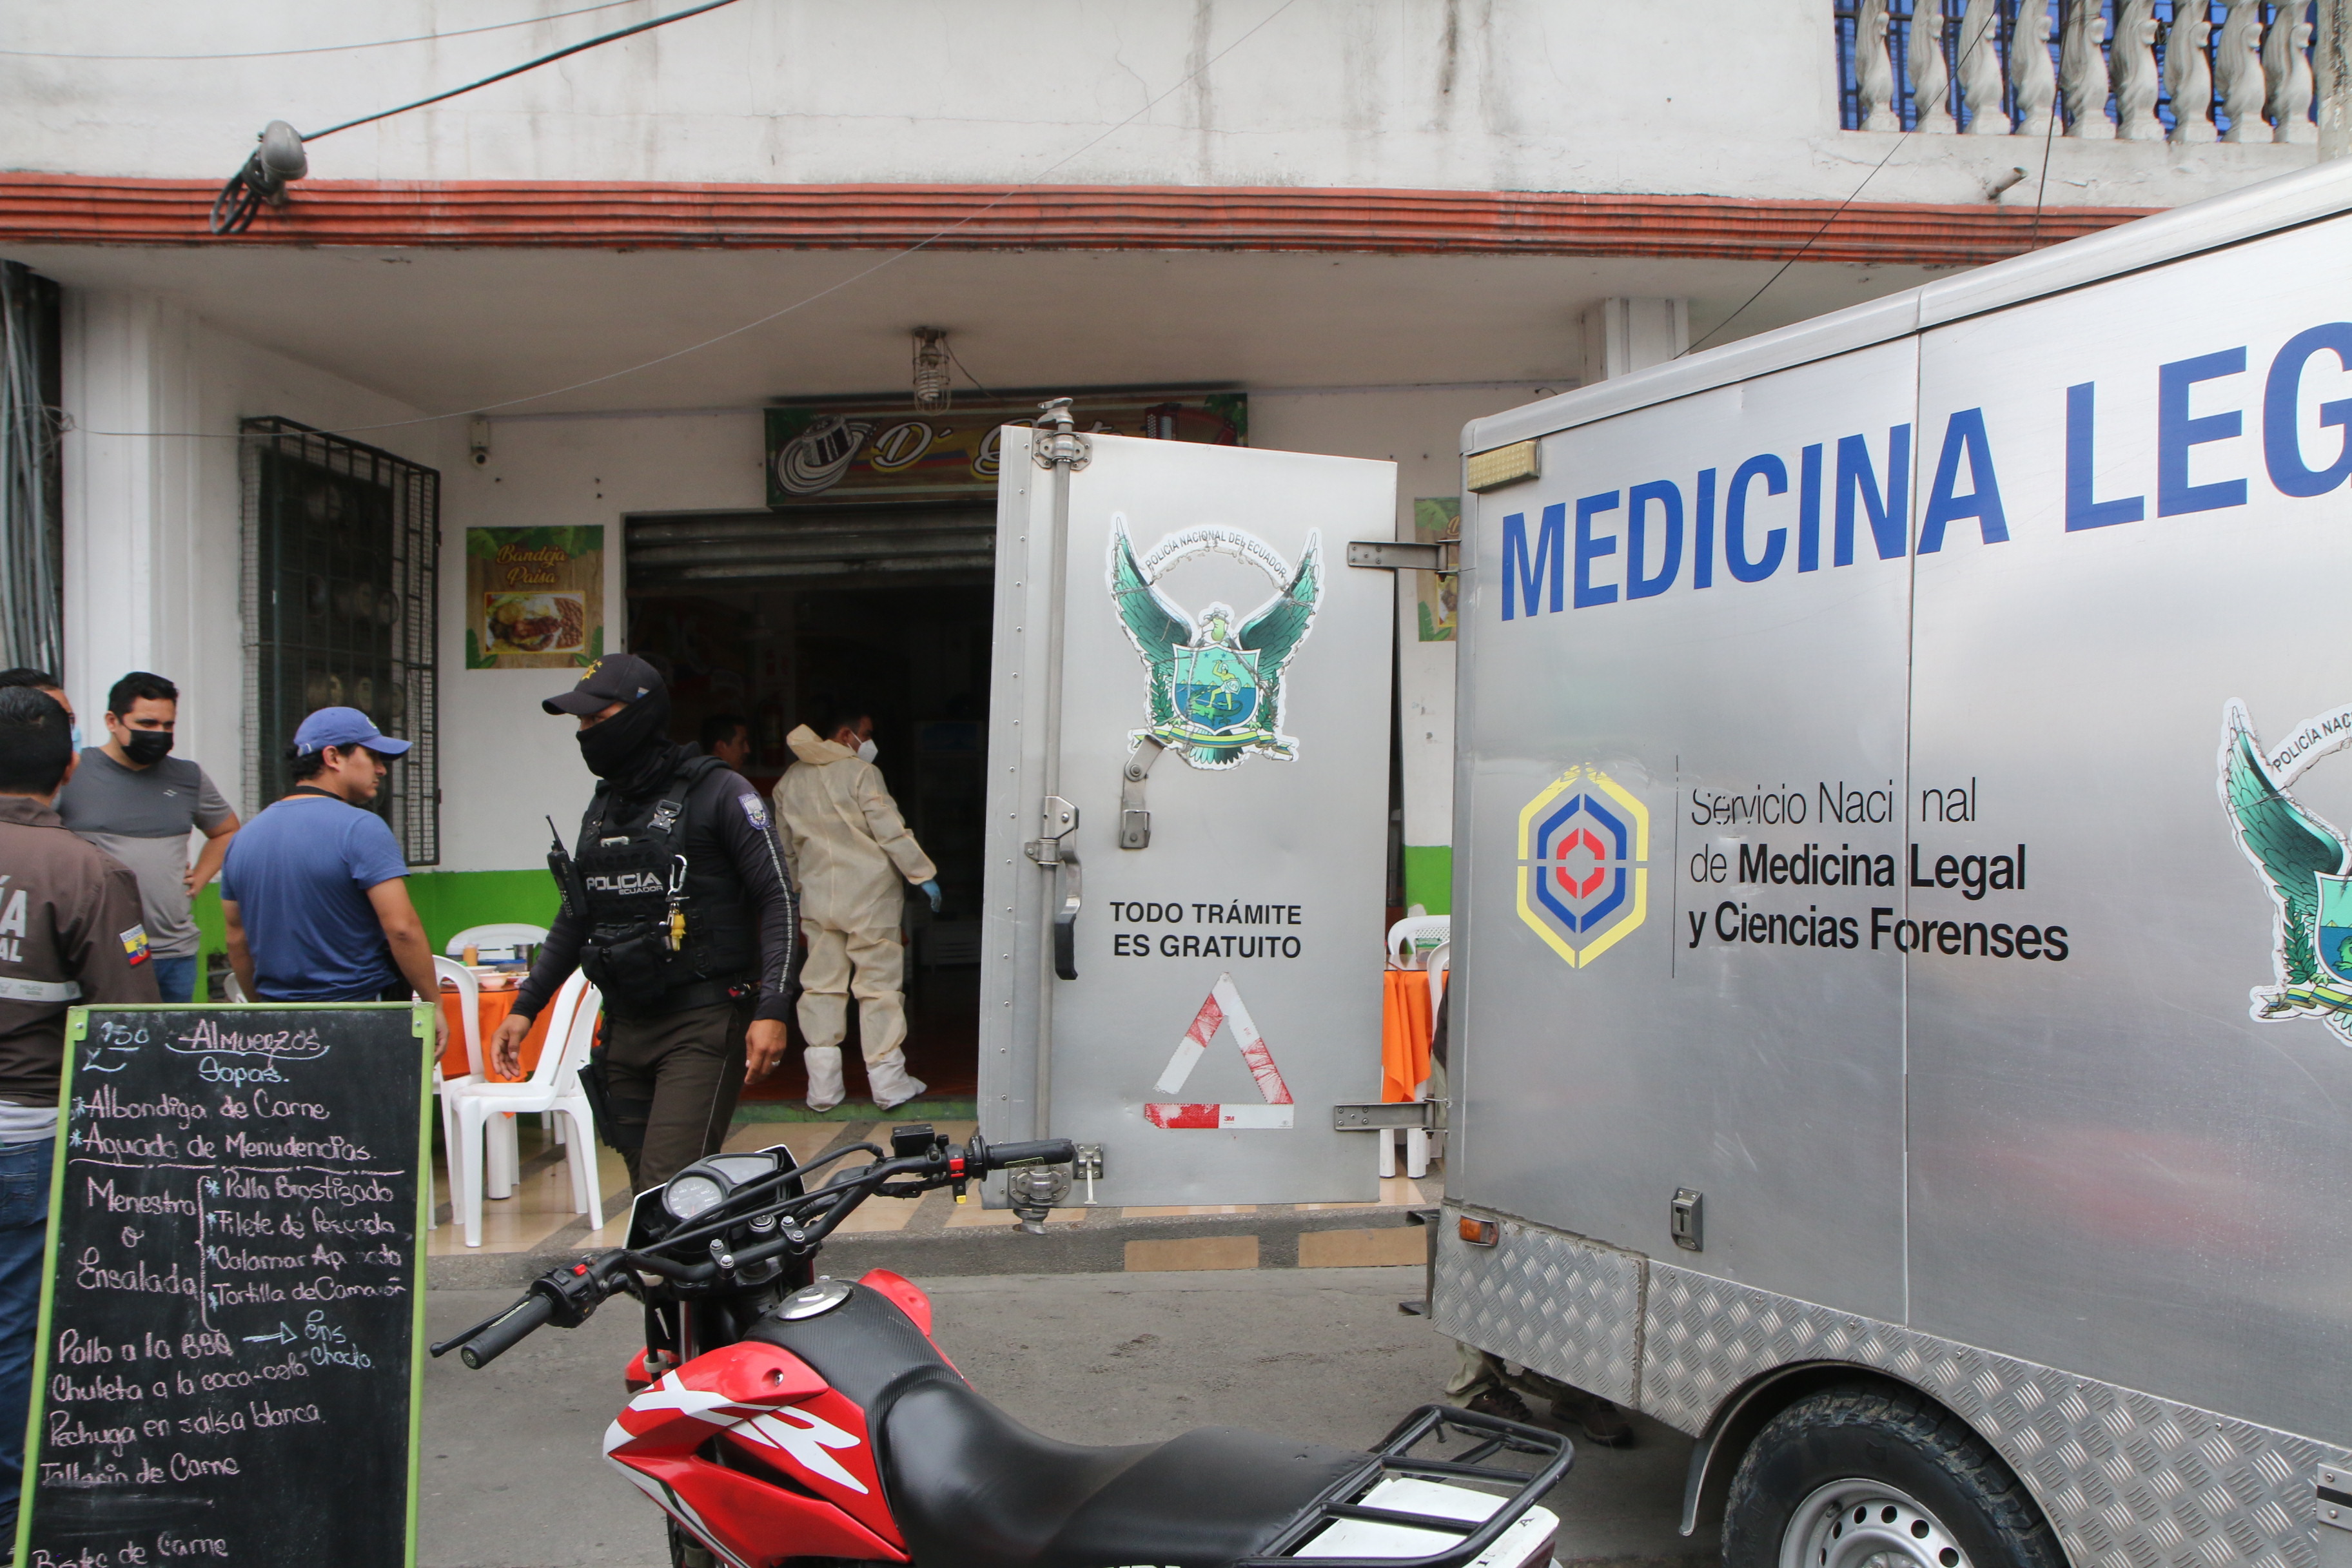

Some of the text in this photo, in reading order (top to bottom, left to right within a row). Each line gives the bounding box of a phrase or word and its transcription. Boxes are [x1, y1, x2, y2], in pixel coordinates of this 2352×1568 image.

[1501, 407, 2009, 622] MEDICINA
[496, 544, 567, 567] Bandeja
[1145, 530, 1287, 579] POLICÍA NACIONAL DEL ECUADOR
[507, 566, 556, 586] Paisa
[2273, 712, 2352, 773] POLICÍA NAC
[1692, 777, 1977, 826] Servicio Nacinal
[1690, 843, 2026, 901] de Medicina Legal
[618, 885, 663, 895] ECUADOR
[1110, 899, 1302, 925] TODO TRÁMITE
[1114, 934, 1301, 958] ES GRATUITO
[1689, 901, 2070, 962] y Ciencias Forenses
[84, 1084, 331, 1130] Albondiga de Carne
[83, 1122, 178, 1162] Aguado
[188, 1135, 216, 1158] de
[87, 1176, 196, 1215] Menestra
[220, 1170, 270, 1199] Pollo
[121, 1226, 144, 1247] o
[214, 1206, 395, 1239] Filete de Pescado
[76, 1247, 199, 1301] Ensalada
[216, 1246, 306, 1270] Calamar
[212, 1276, 406, 1305] Tortilla de Camaón
[59, 1329, 113, 1364] Pollo
[122, 1344, 137, 1361] a
[146, 1332, 172, 1359] la
[52, 1373, 143, 1402] Chuleta
[153, 1382, 168, 1398] a
[177, 1371, 195, 1395] la
[49, 1411, 137, 1457] Pechuga
[143, 1420, 172, 1438] en
[179, 1407, 246, 1435] salsa
[136, 1457, 166, 1484] de
[171, 1452, 240, 1481] Carne
[119, 1541, 147, 1565] de
[158, 1531, 228, 1557] Carne
